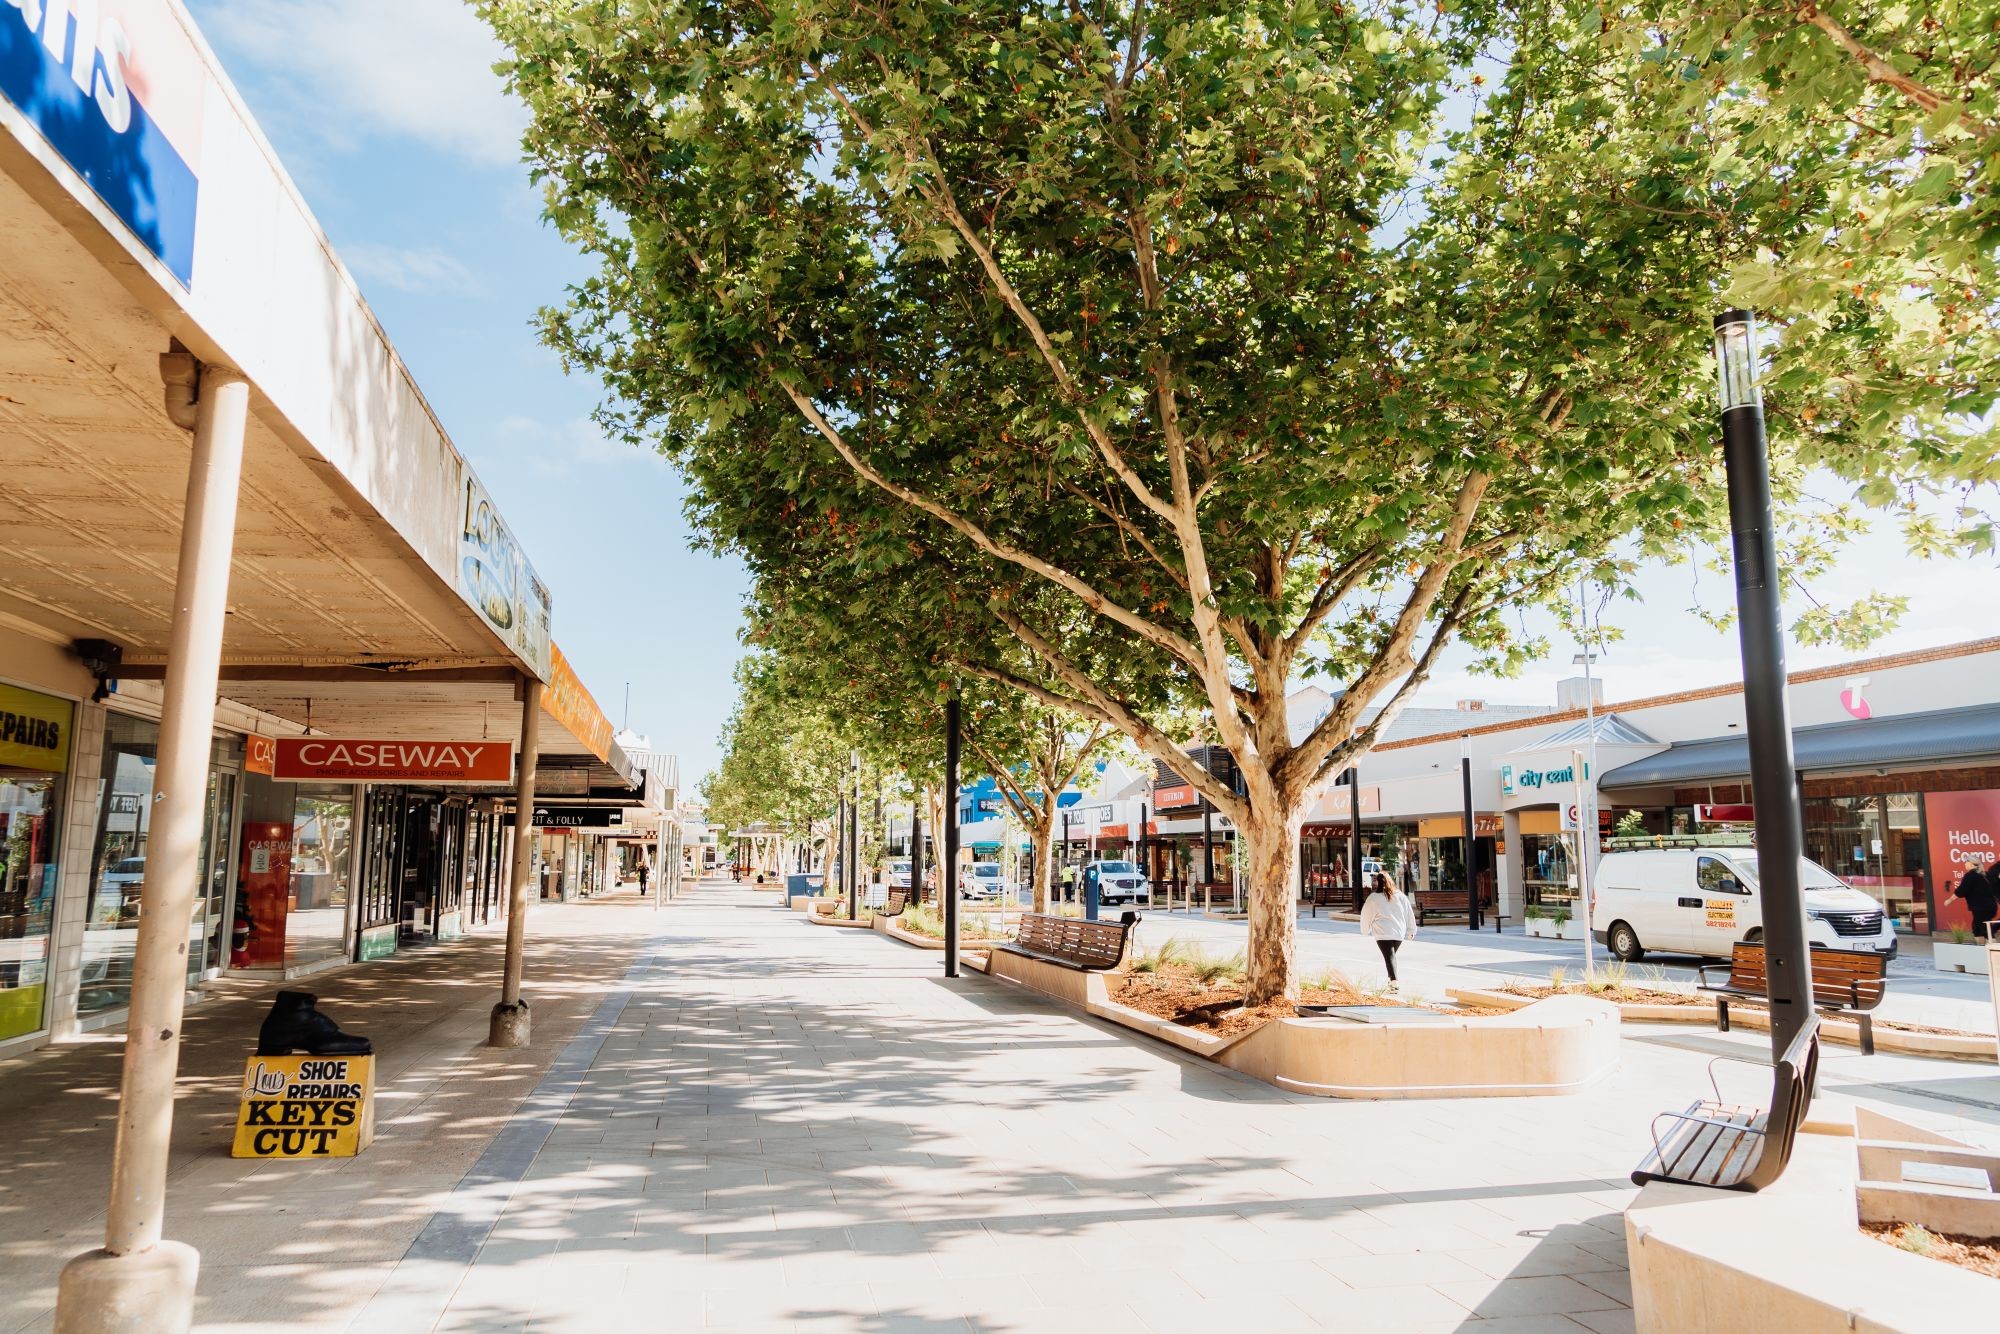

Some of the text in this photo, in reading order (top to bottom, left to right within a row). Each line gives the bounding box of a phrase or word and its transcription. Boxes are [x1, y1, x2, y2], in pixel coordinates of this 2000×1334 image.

[300, 743, 483, 768] CASEWAY
[316, 768, 347, 776] PHONE
[1519, 763, 1589, 789] city centl
[556, 816, 584, 825] FOLLY
[1306, 827, 1352, 837] KaTies
[1948, 829, 1994, 847] Hello,
[243, 1062, 294, 1098] Lou's
[299, 1061, 348, 1081] SHOE
[286, 1083, 362, 1099] REPAIRS
[244, 1100, 357, 1126] KEYS
[253, 1128, 338, 1156] CUT
